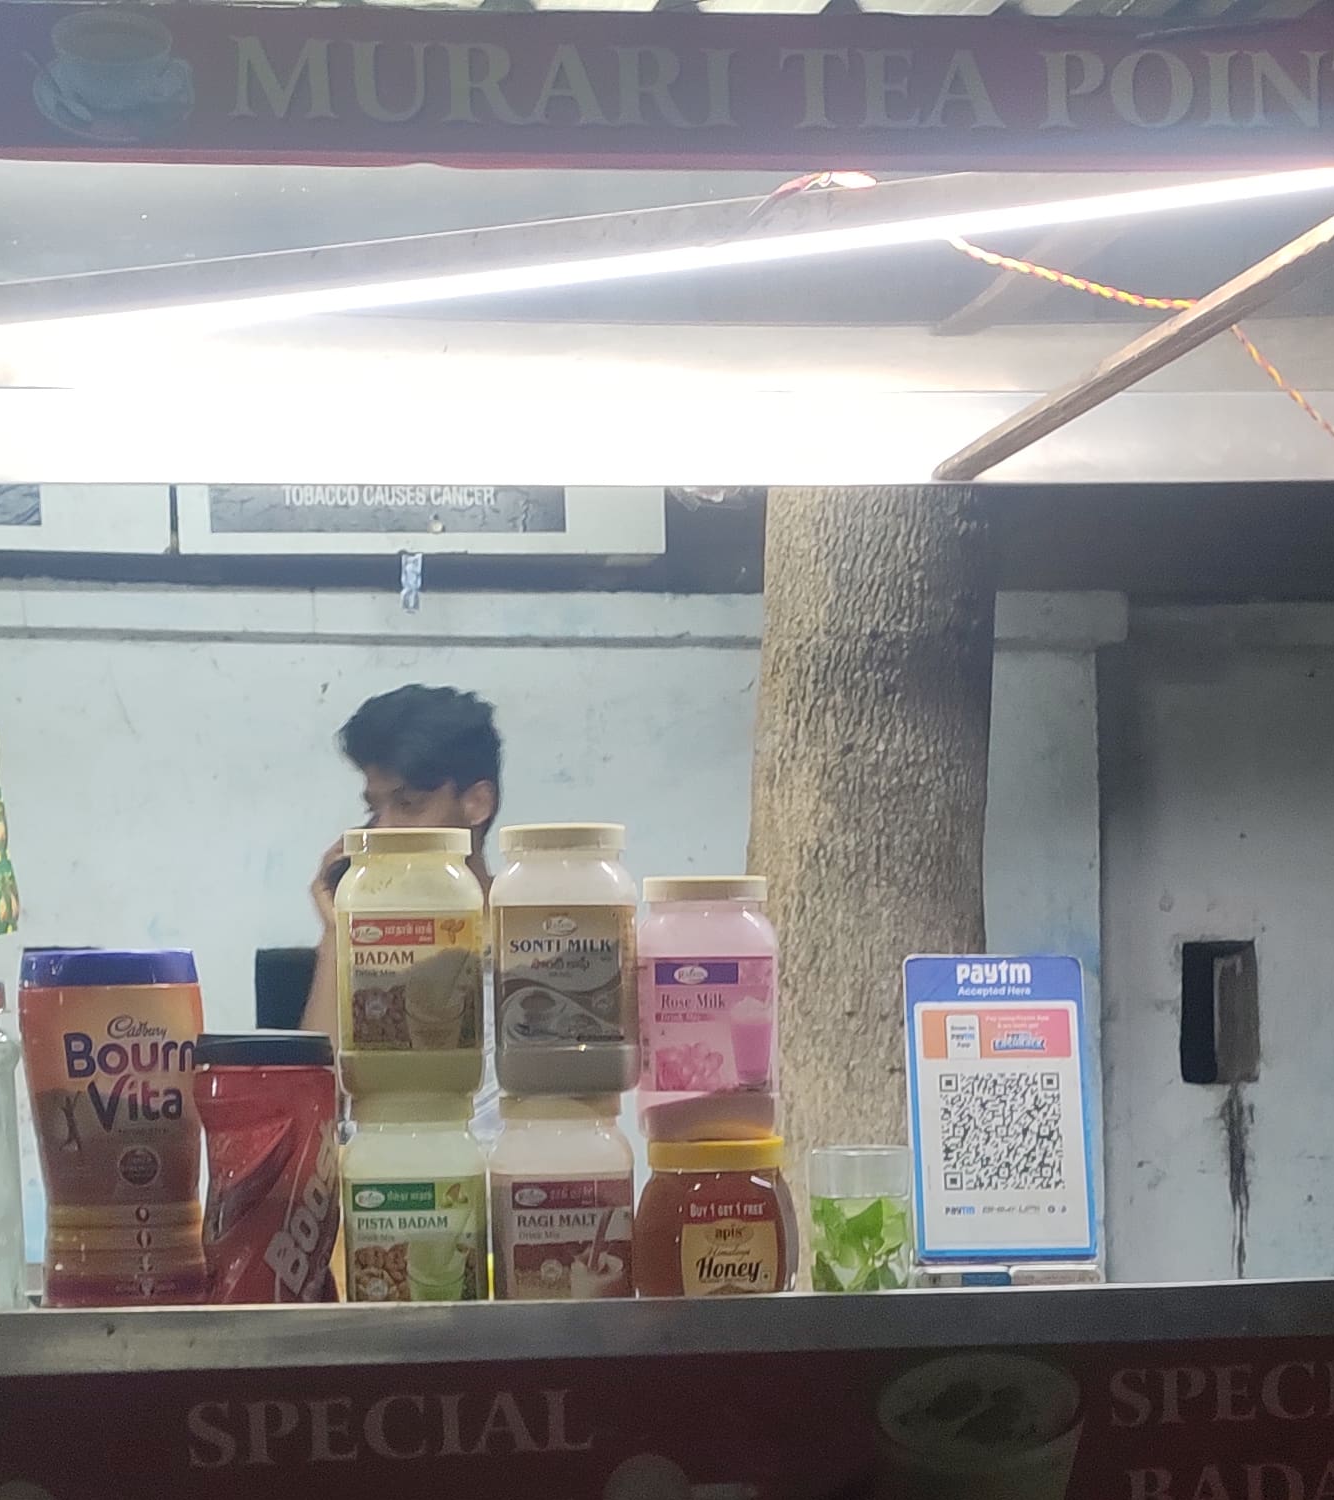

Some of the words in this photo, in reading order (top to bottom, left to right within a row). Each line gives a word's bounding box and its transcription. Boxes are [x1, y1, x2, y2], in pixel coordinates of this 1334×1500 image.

[230, 32, 735, 129] MURARI
[779, 46, 1005, 131] TEA
[282, 484, 359, 506] TOBACCO
[362, 485, 426, 506] CAUSES
[430, 485, 495, 506] CANCER
[509, 939, 561, 954] SONTI
[567, 939, 612, 953] MILK
[354, 950, 415, 966] BADAM
[661, 992, 692, 1009] Rose
[696, 992, 726, 1009] Milk
[957, 986, 1006, 997] Accepted
[1008, 986, 1031, 996] Here
[107, 1014, 168, 1041] Cadbury
[63, 1032, 196, 1078] Bourn
[87, 1074, 183, 1132] Vita
[357, 1217, 394, 1230] PISTA
[398, 1215, 448, 1228] BADAM
[517, 1214, 555, 1228] RAGI
[558, 1213, 597, 1227] MALT
[715, 1224, 743, 1241] apis
[696, 1257, 764, 1283] Honey
[186, 1388, 593, 1469] SPECIAL
